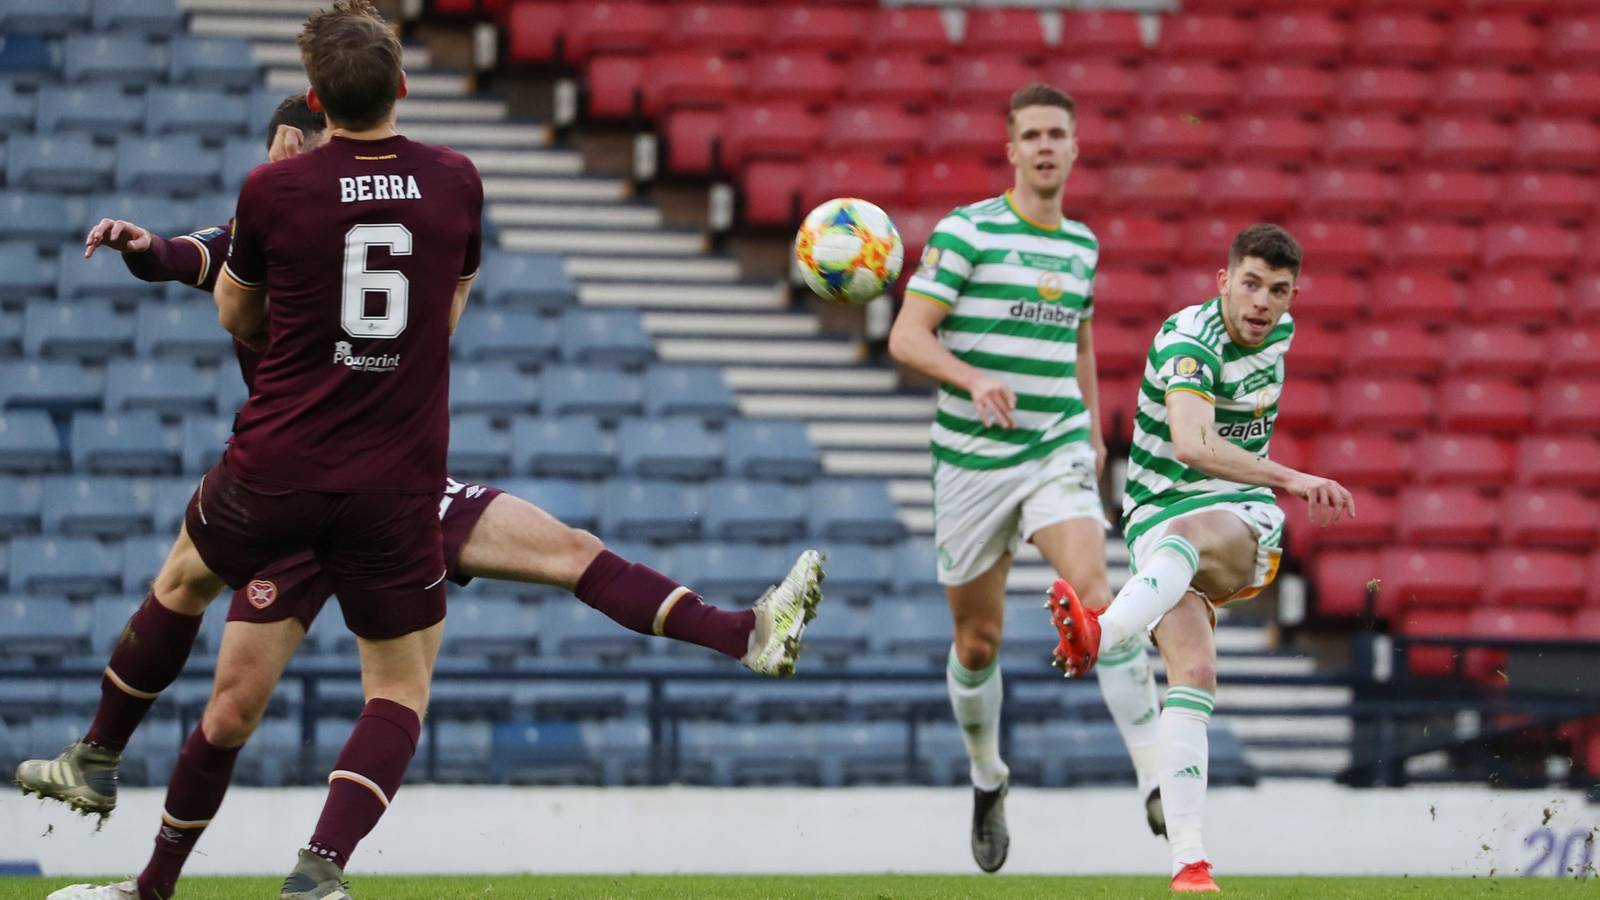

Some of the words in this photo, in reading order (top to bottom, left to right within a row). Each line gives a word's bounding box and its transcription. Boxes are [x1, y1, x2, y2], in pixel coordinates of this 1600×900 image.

[339, 174, 422, 203] BERRA
[341, 223, 412, 338] 6
[1010, 299, 1078, 325] dafabe
[1524, 828, 1595, 877] 20
